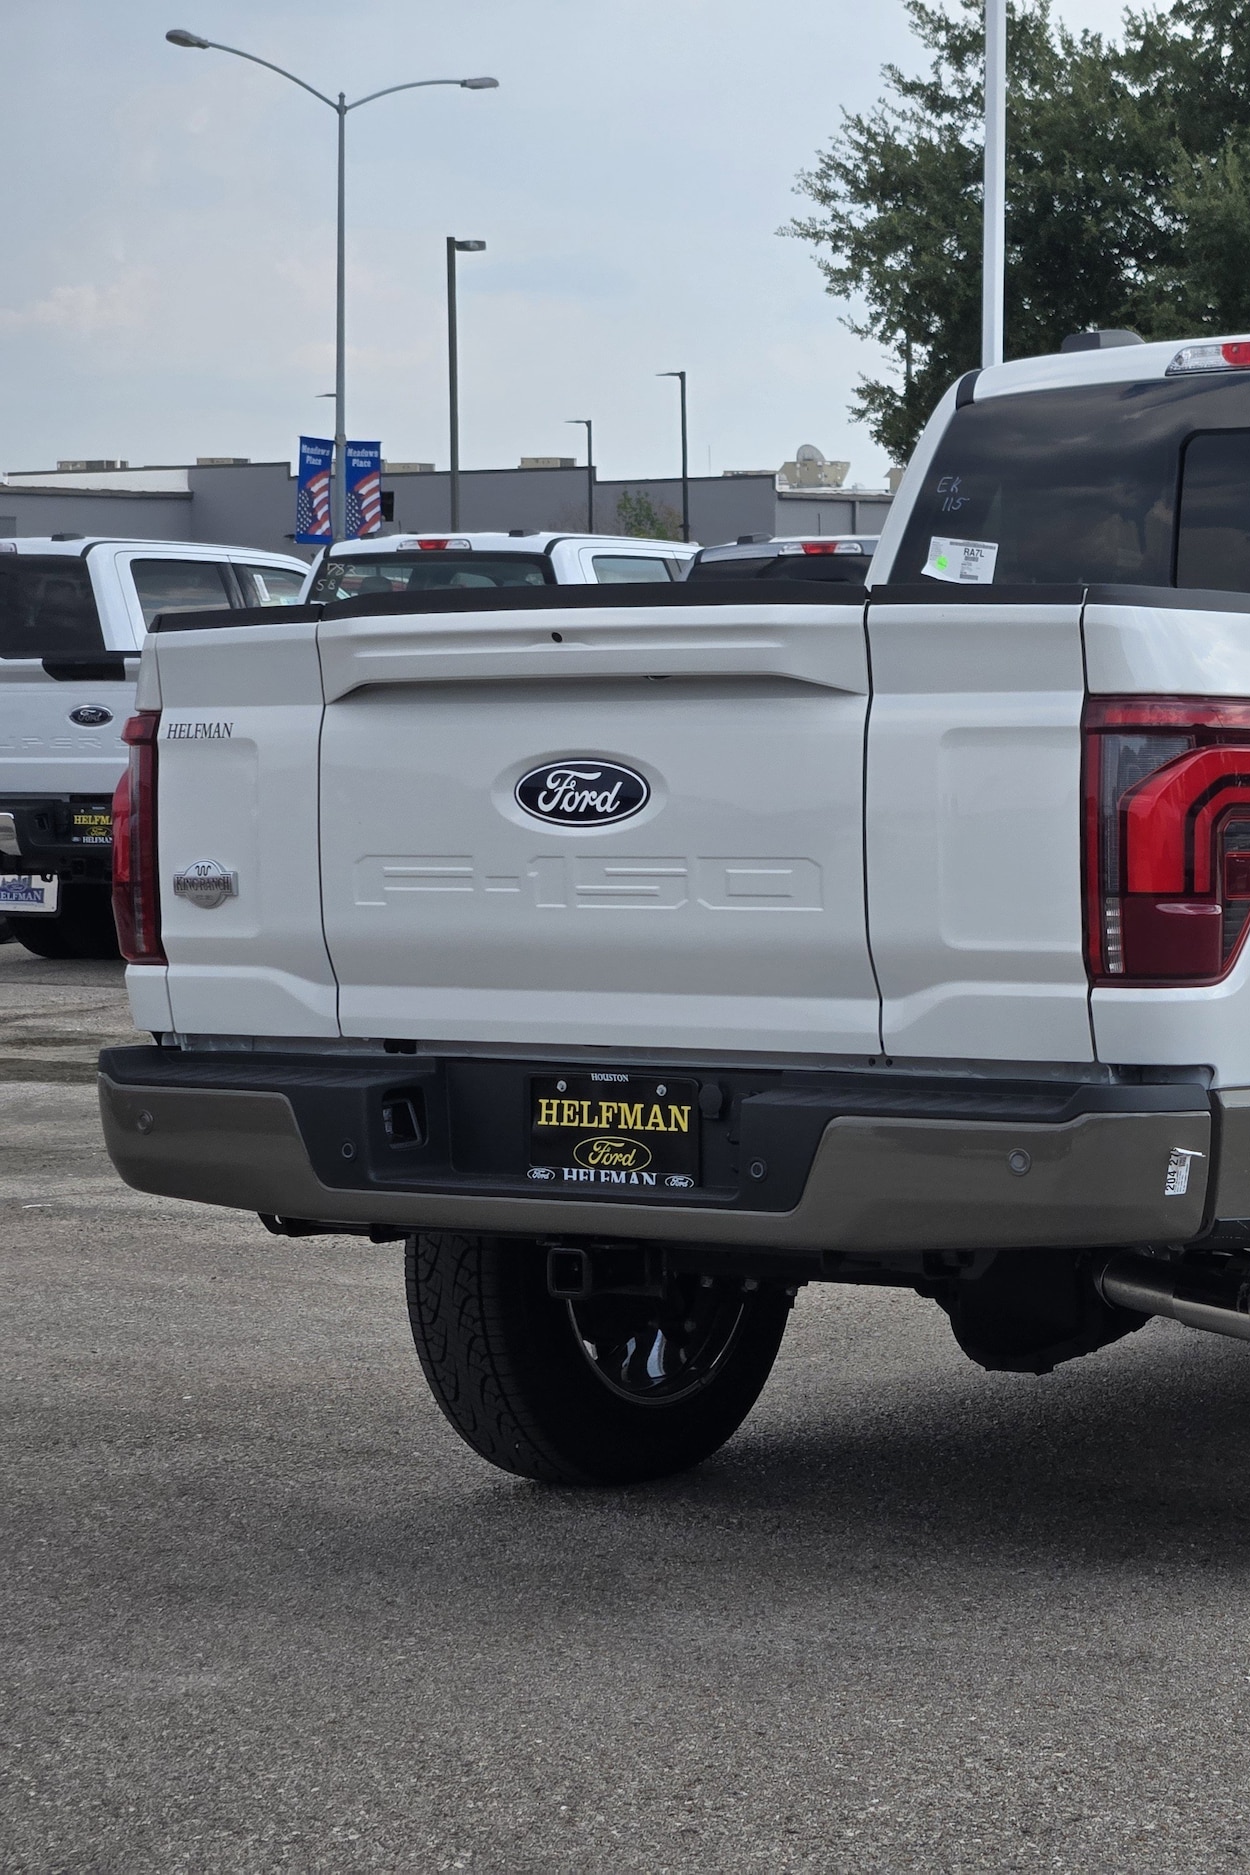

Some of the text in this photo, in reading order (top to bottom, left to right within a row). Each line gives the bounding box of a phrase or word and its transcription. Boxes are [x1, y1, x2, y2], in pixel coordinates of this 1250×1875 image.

[301, 444, 331, 456] Meadows
[346, 448, 379, 458] Meadows
[305, 455, 322, 466] Place
[351, 459, 371, 468] Place
[941, 496, 971, 512] 115
[963, 547, 985, 558] RA7L
[167, 722, 234, 740] HELFMAN
[536, 769, 624, 814] Ford
[73, 815, 113, 826] HELFM
[176, 876, 231, 891] KING RANCH
[354, 854, 824, 911] F-150
[0, 890, 43, 901] ELFMAN
[590, 1073, 629, 1083] HOUSTON
[537, 1098, 692, 1133] HELFMAN
[588, 1140, 637, 1167] Ford
[1166, 1170, 1177, 1191] 204
